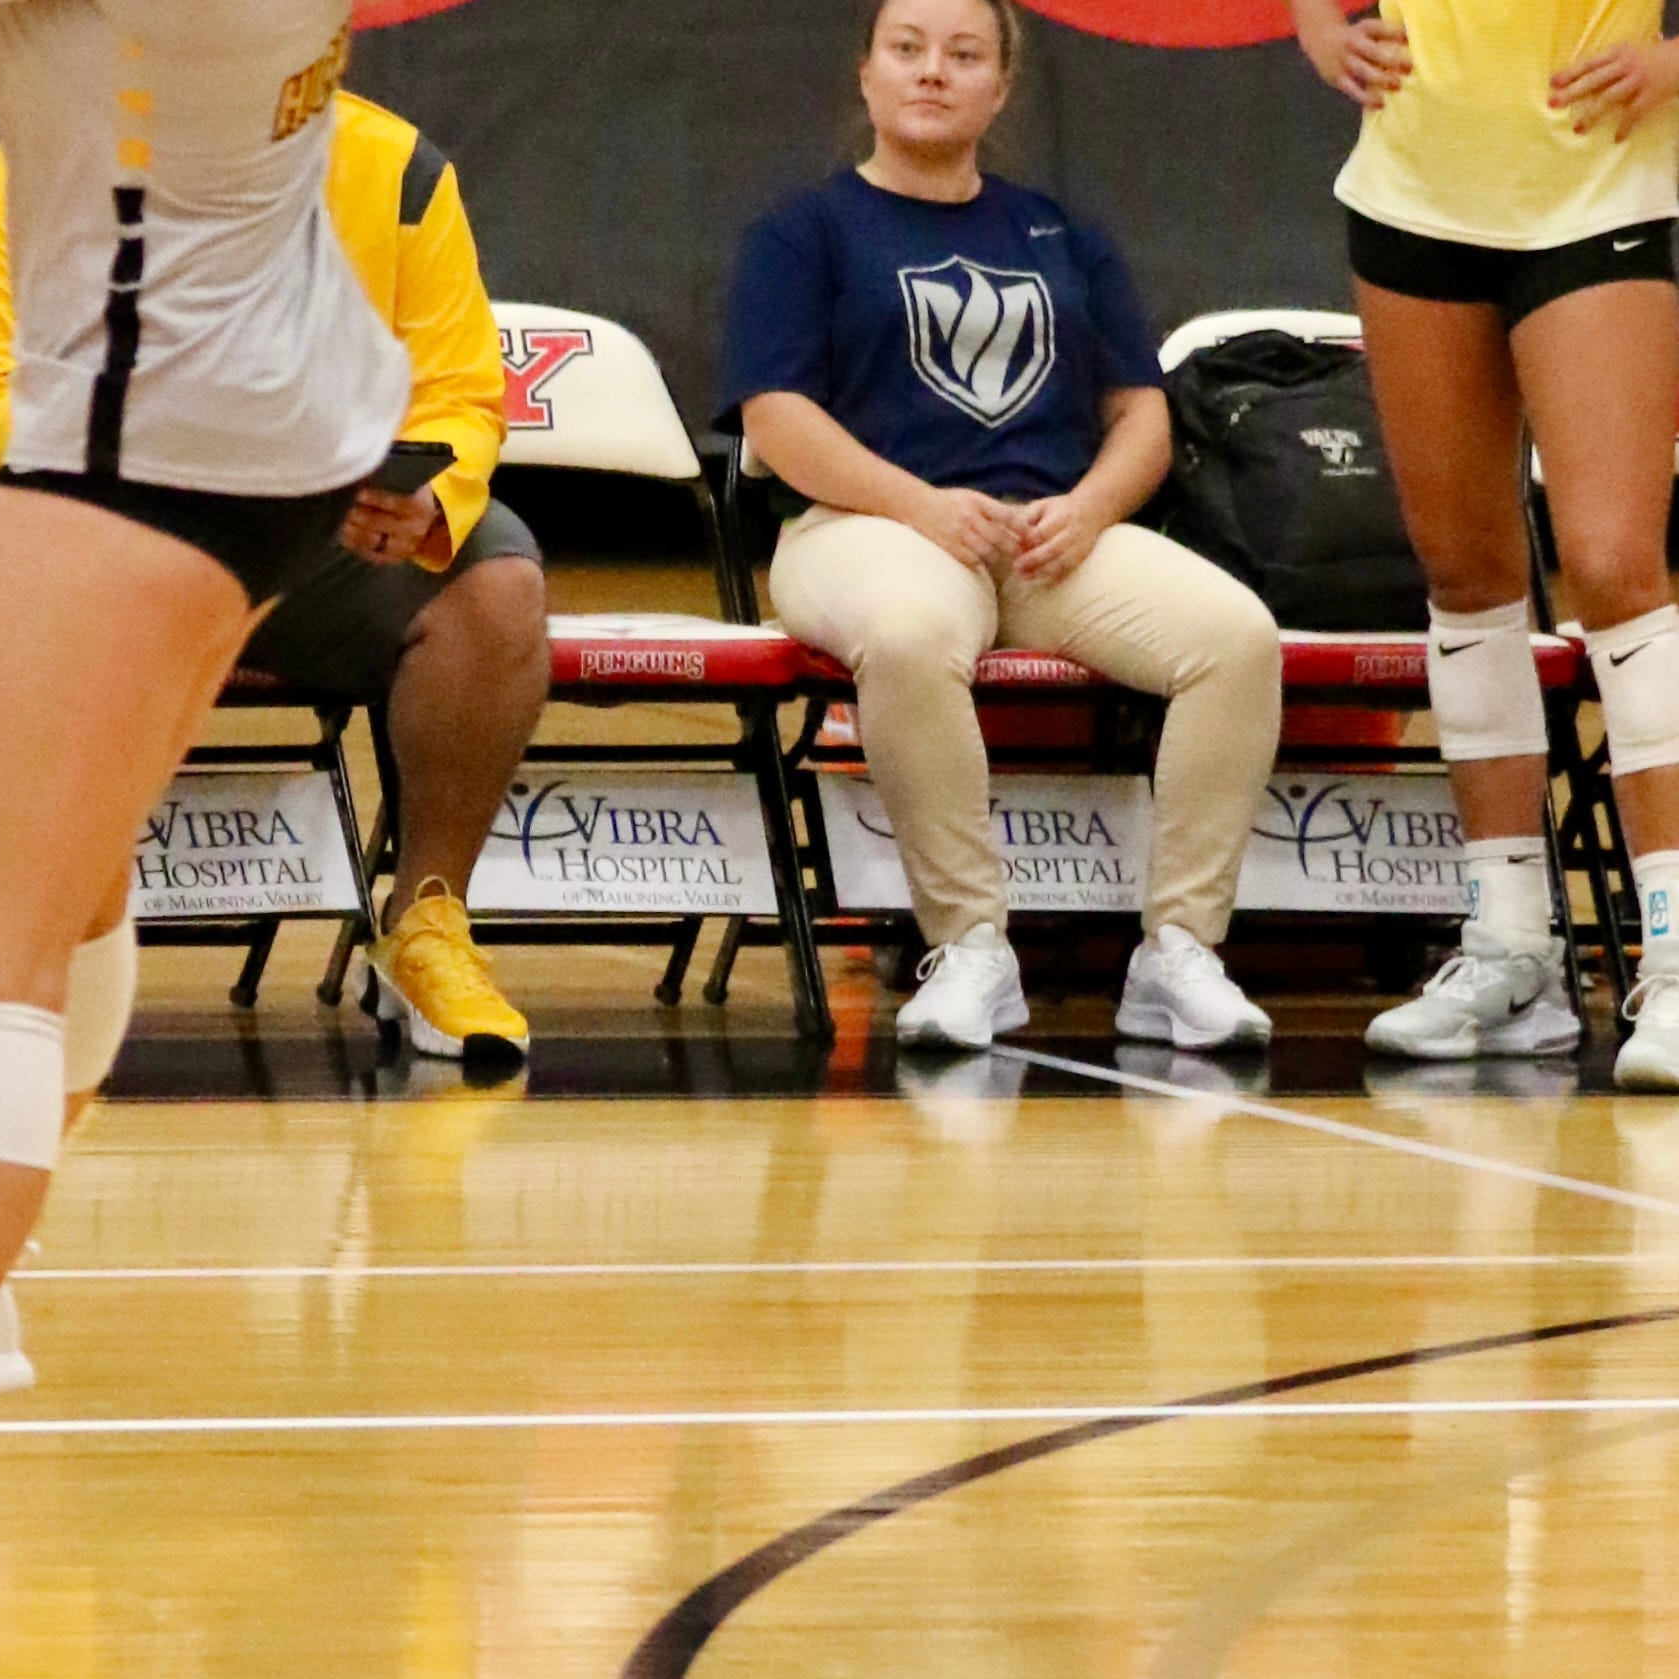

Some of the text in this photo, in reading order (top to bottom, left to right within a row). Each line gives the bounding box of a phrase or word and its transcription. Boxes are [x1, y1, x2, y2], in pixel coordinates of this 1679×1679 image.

[580, 650, 705, 679] PENGUINS
[554, 796, 726, 846] VIBRA
[1332, 798, 1465, 848] VIBR
[135, 854, 324, 889] HOSPITAL
[554, 847, 743, 885] HOSPITAL
[1330, 849, 1468, 886] HOSPIT
[144, 890, 324, 912] OF MAHONING VALLEY
[582, 888, 681, 907] MAHONING
[683, 889, 743, 906] VALLEY
